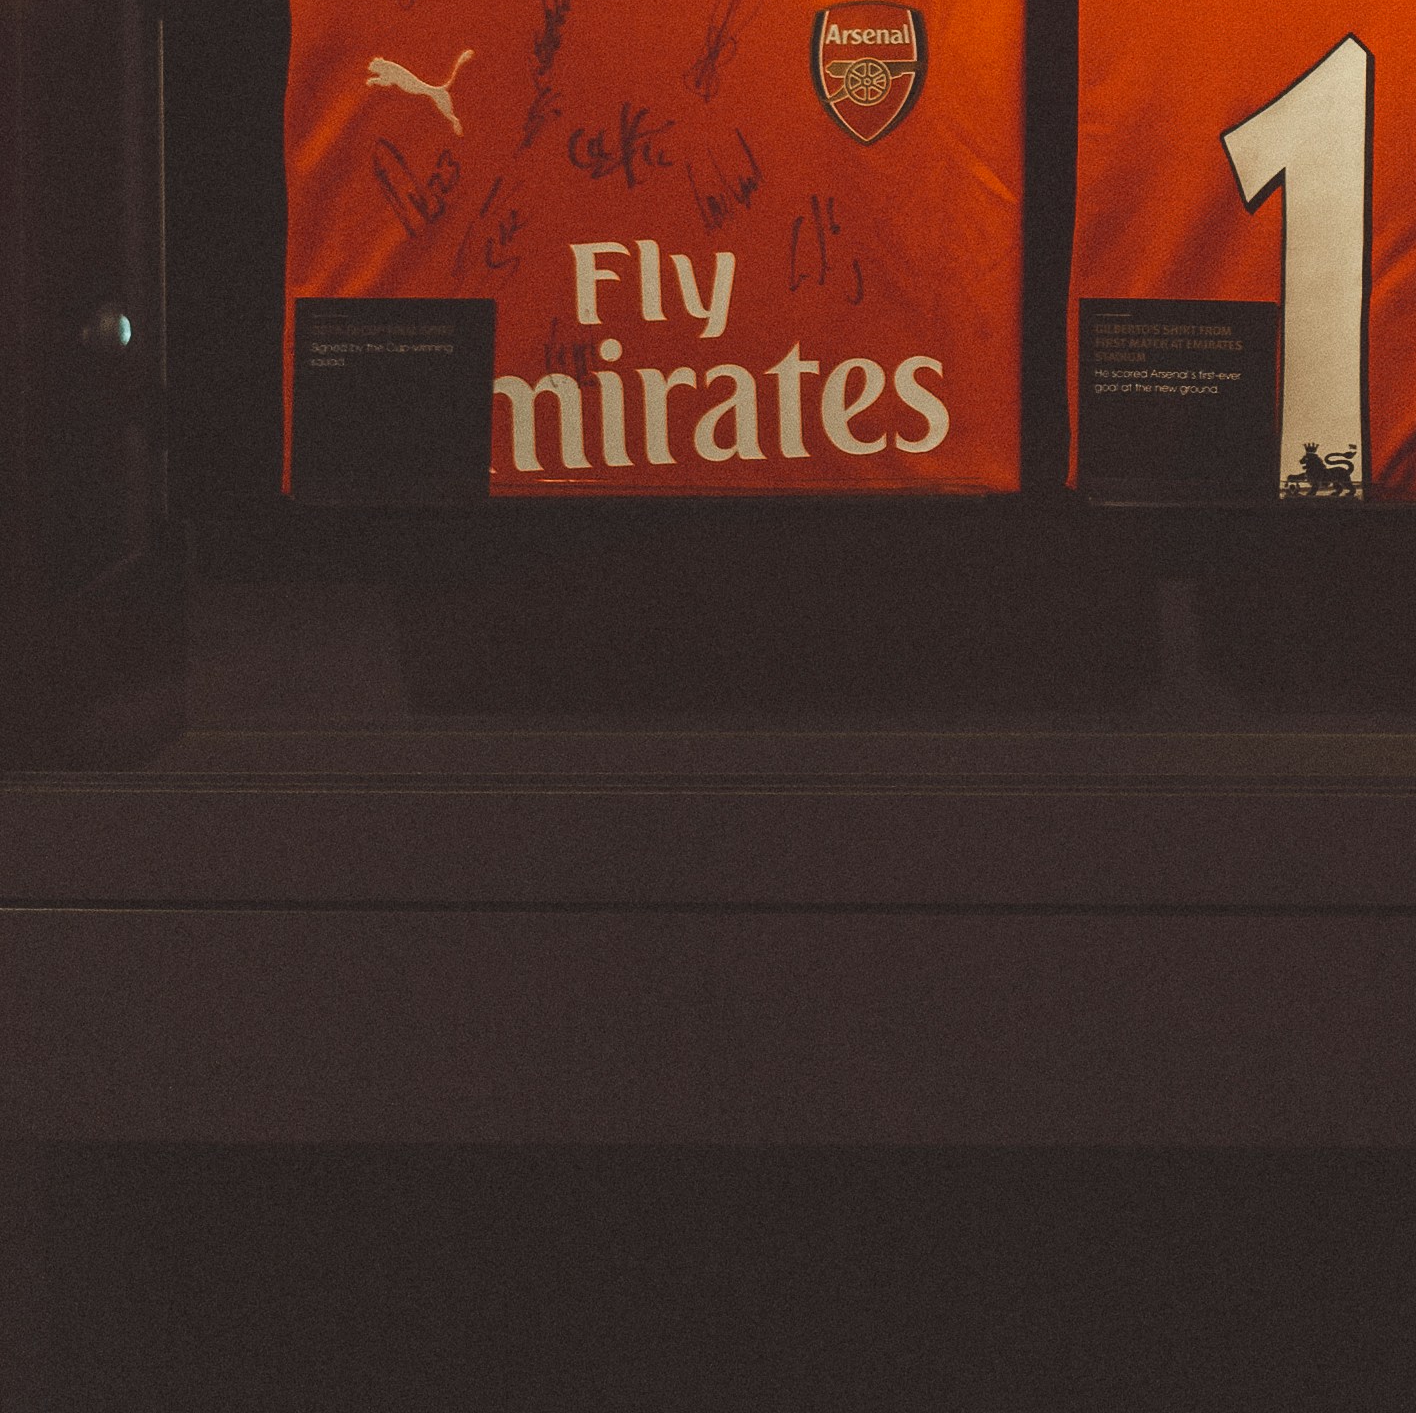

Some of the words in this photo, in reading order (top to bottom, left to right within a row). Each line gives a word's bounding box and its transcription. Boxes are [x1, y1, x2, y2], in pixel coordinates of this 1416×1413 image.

[825, 24, 910, 44] Arsenal
[571, 240, 736, 339] Fly
[1200, 327, 1232, 336] FROM
[1095, 370, 1109, 378] He
[1112, 370, 1148, 378] scored
[1095, 383, 1118, 394] goal
[1122, 384, 1132, 392] at
[1135, 384, 1151, 392] the
[493, 338, 950, 472] mirates
